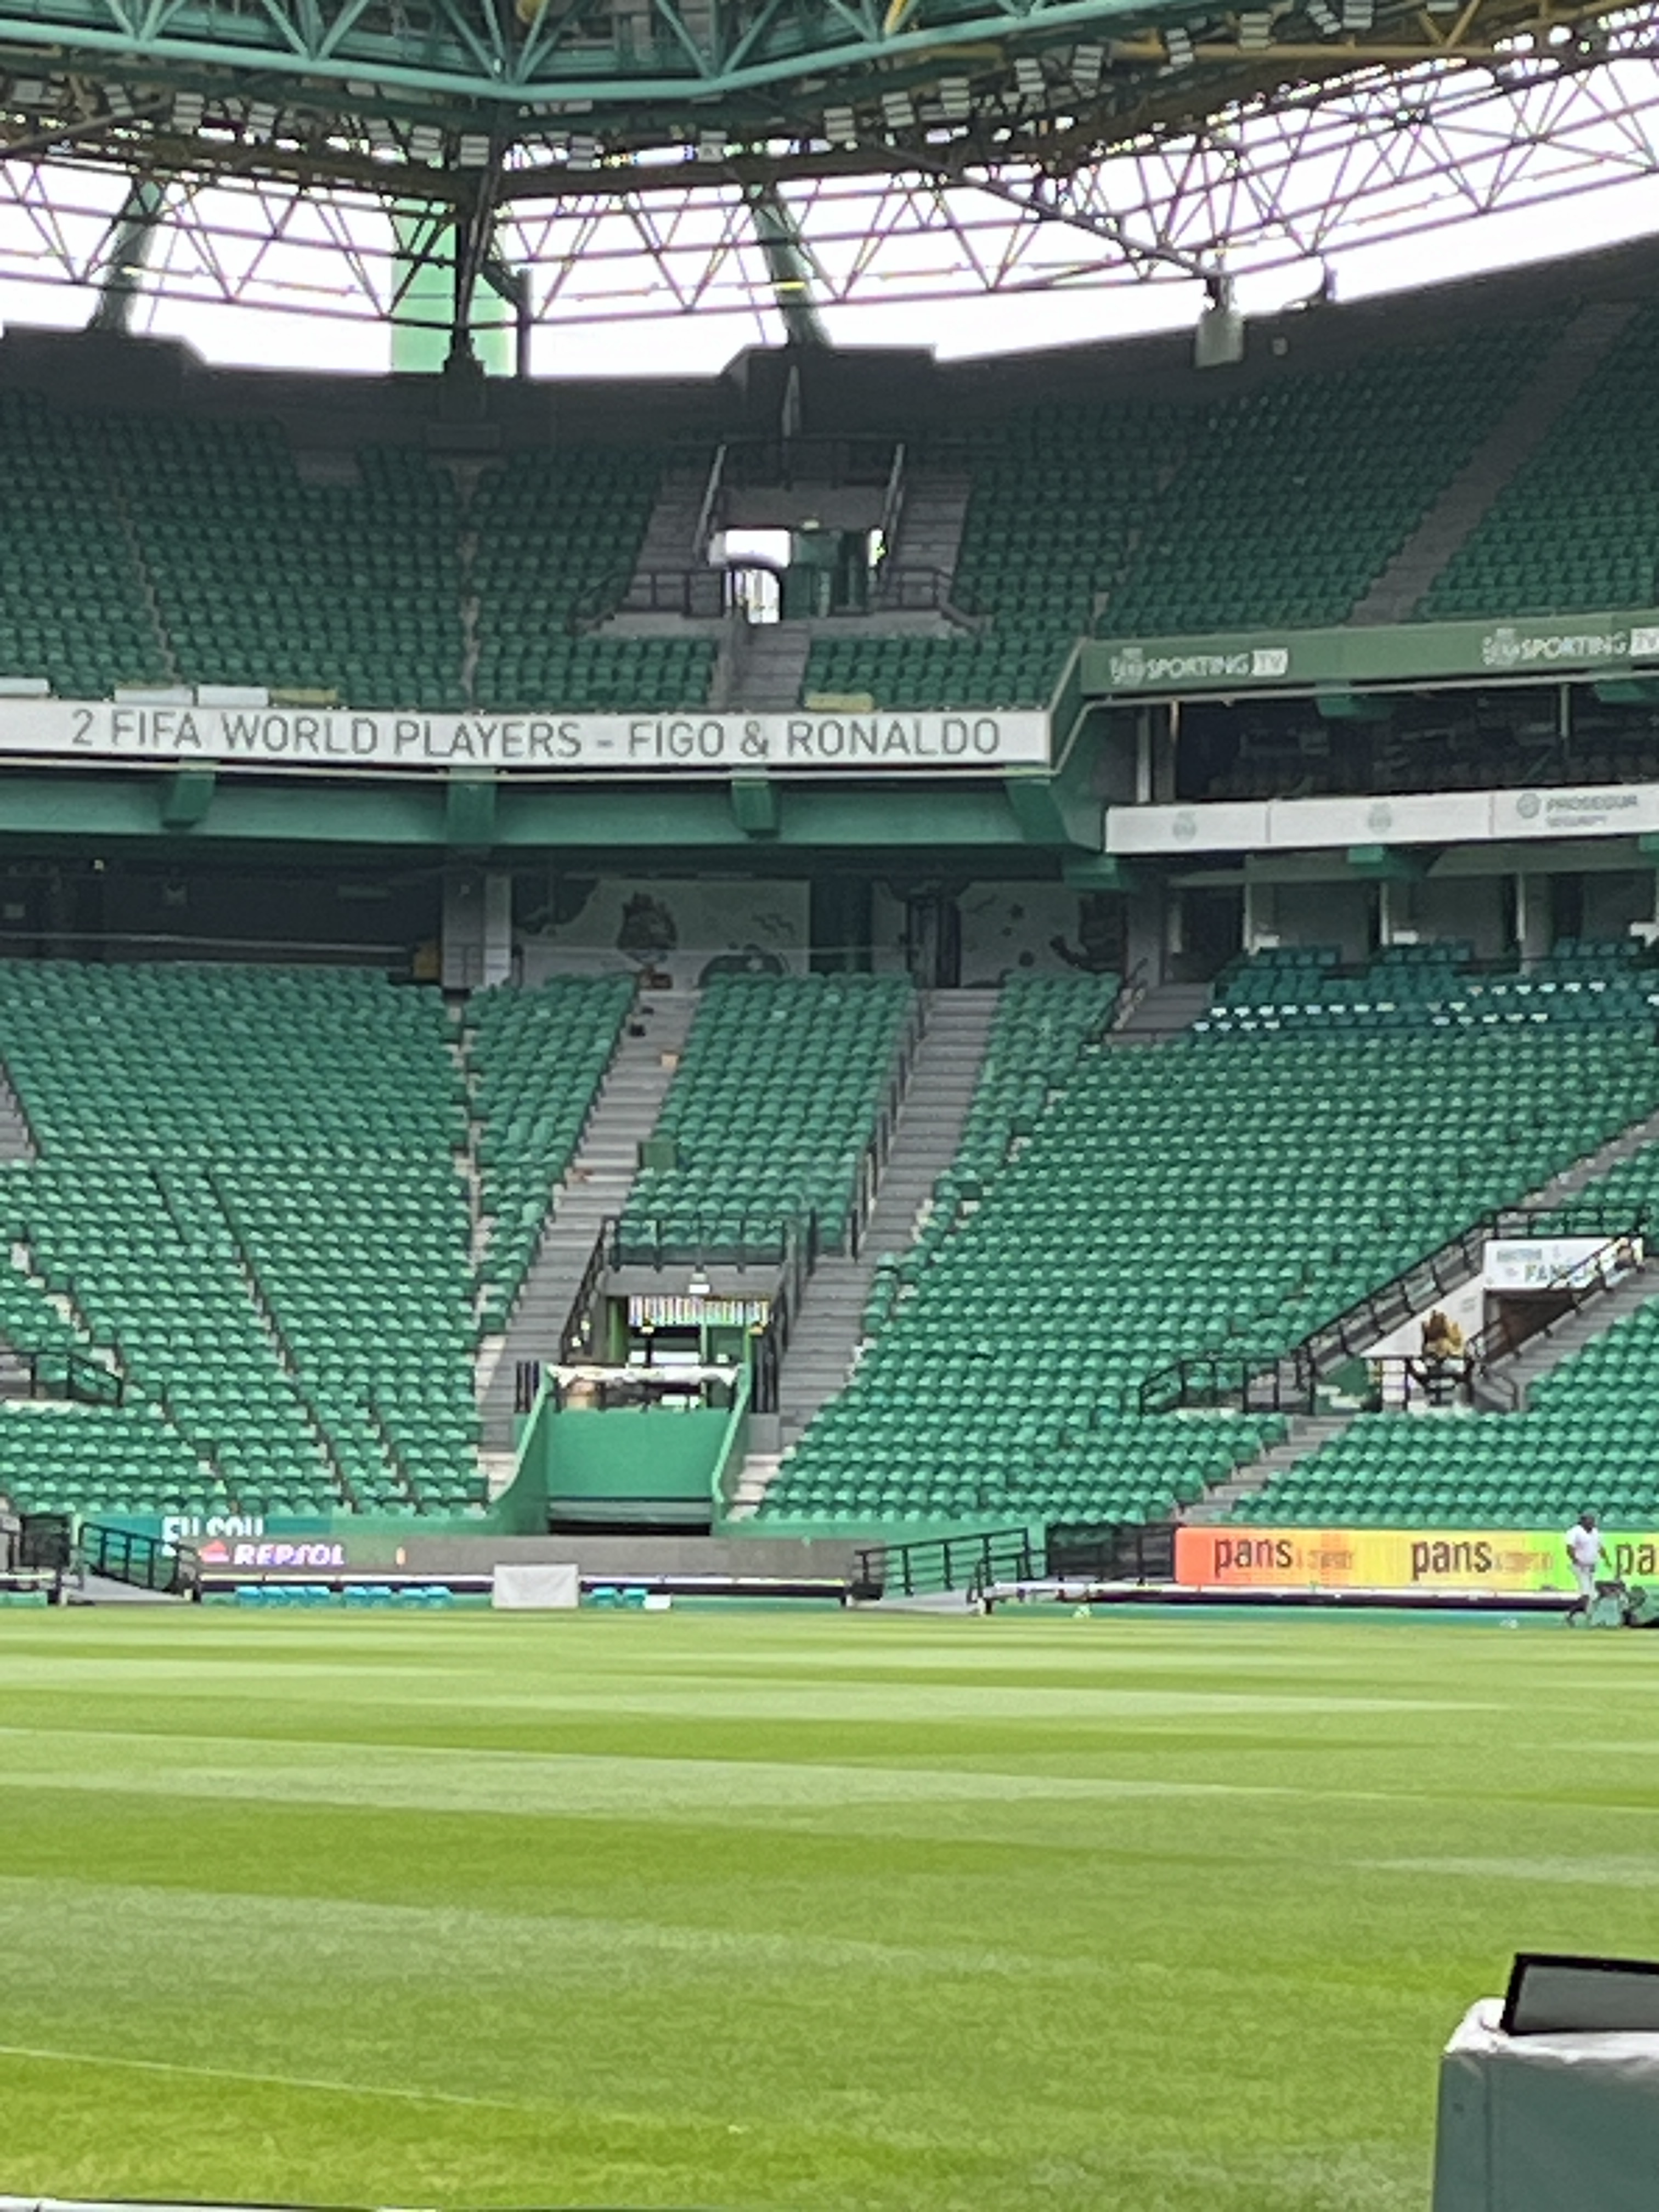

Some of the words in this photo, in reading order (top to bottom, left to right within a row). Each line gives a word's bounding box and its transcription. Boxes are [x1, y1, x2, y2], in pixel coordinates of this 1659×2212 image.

[72, 708, 94, 747] 2
[111, 709, 202, 750] FIFA
[220, 713, 379, 754] WORLD
[394, 718, 582, 758] PLAYERS
[629, 719, 725, 758] FIGO
[739, 719, 768, 758] &
[787, 719, 1001, 756] RONALDO
[234, 1544, 345, 1565] REPSOL
[1215, 1538, 1293, 1578] pans
[1412, 1541, 1492, 1581] pans
